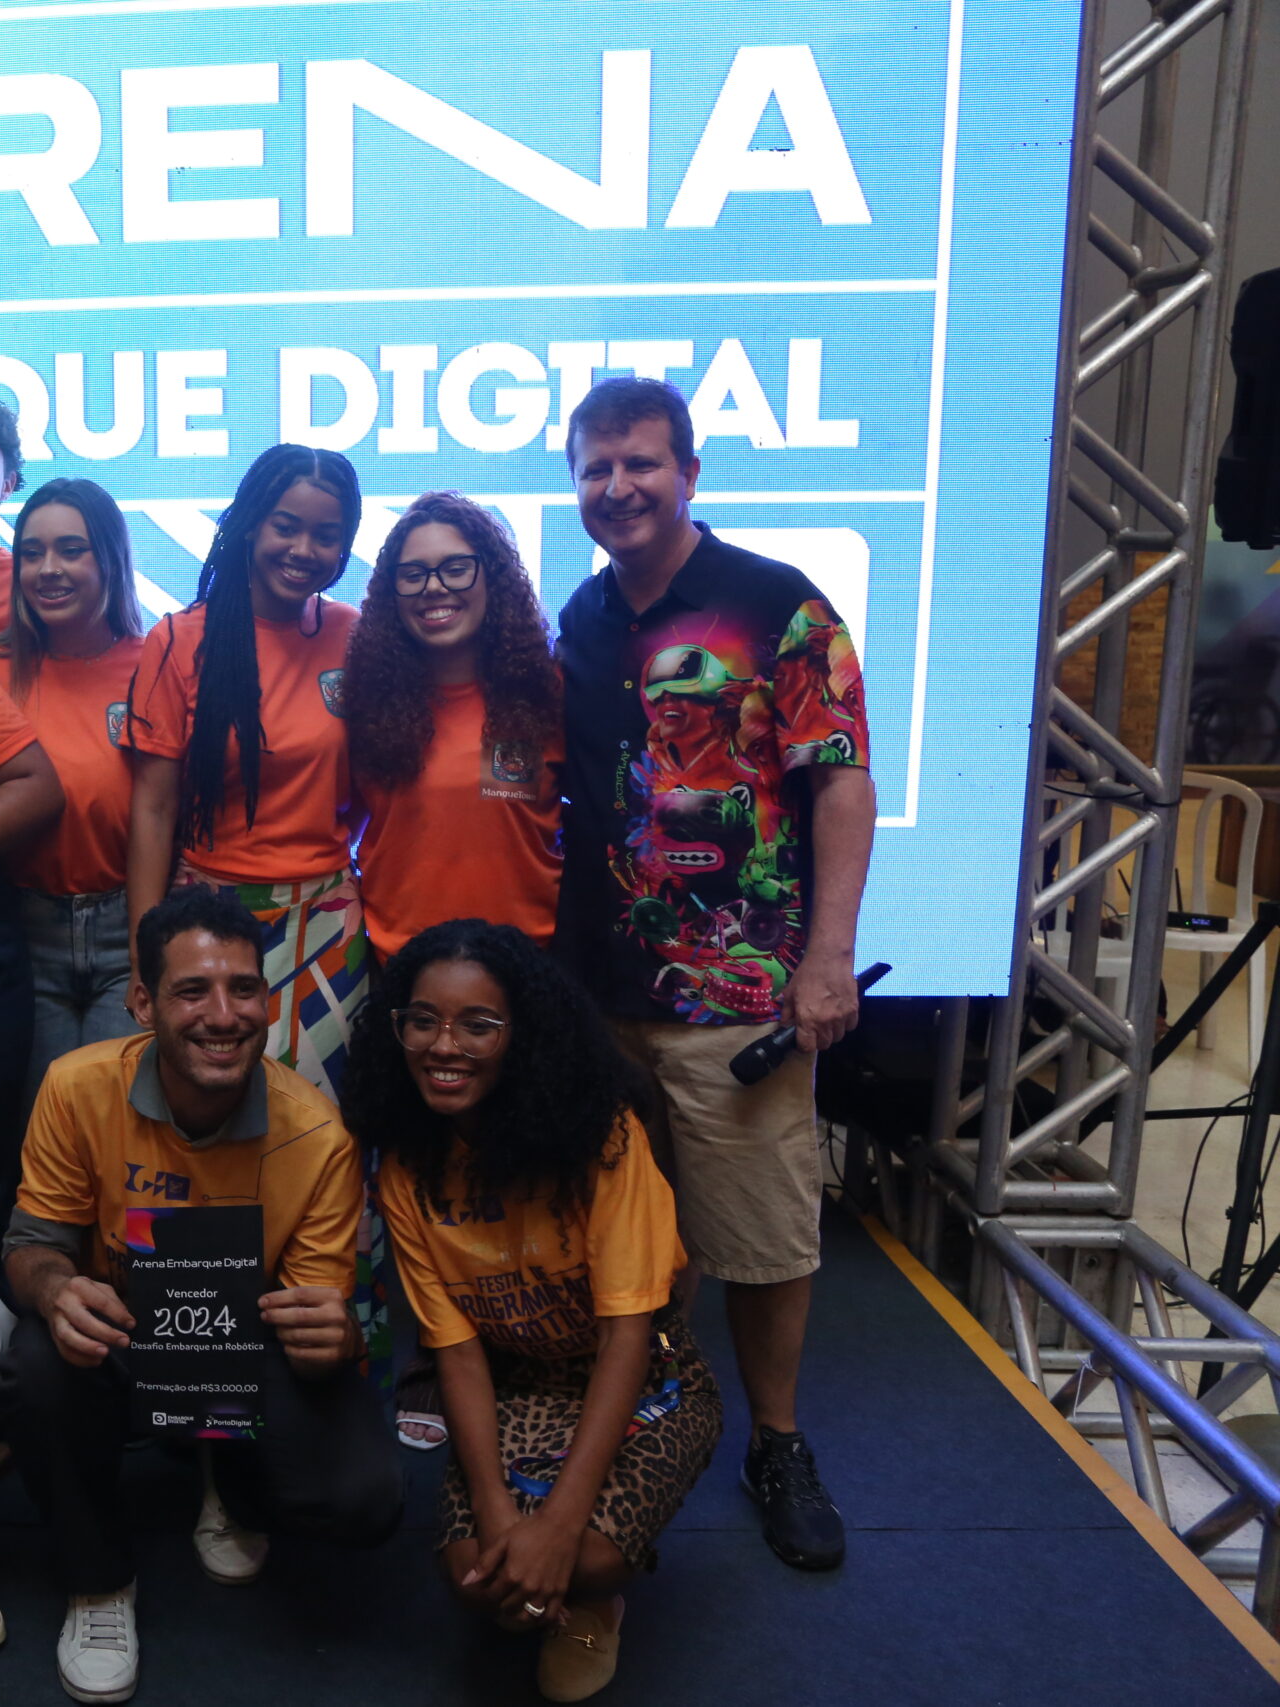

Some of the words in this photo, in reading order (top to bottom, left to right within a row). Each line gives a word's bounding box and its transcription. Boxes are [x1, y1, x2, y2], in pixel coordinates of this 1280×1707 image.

[132, 1258, 165, 1268] Arena
[166, 1258, 222, 1270] Embarque
[224, 1257, 258, 1270] Digital
[166, 1289, 218, 1298] Vencedor
[154, 1305, 237, 1336] 2024
[131, 1342, 164, 1351] Desafio
[166, 1342, 210, 1352] Embarque
[225, 1342, 264, 1351] Robótica
[136, 1381, 186, 1393] Premiação
[188, 1383, 200, 1392] de
[201, 1383, 259, 1393] R$3.000,00
[213, 1419, 252, 1427] PortoDigital
